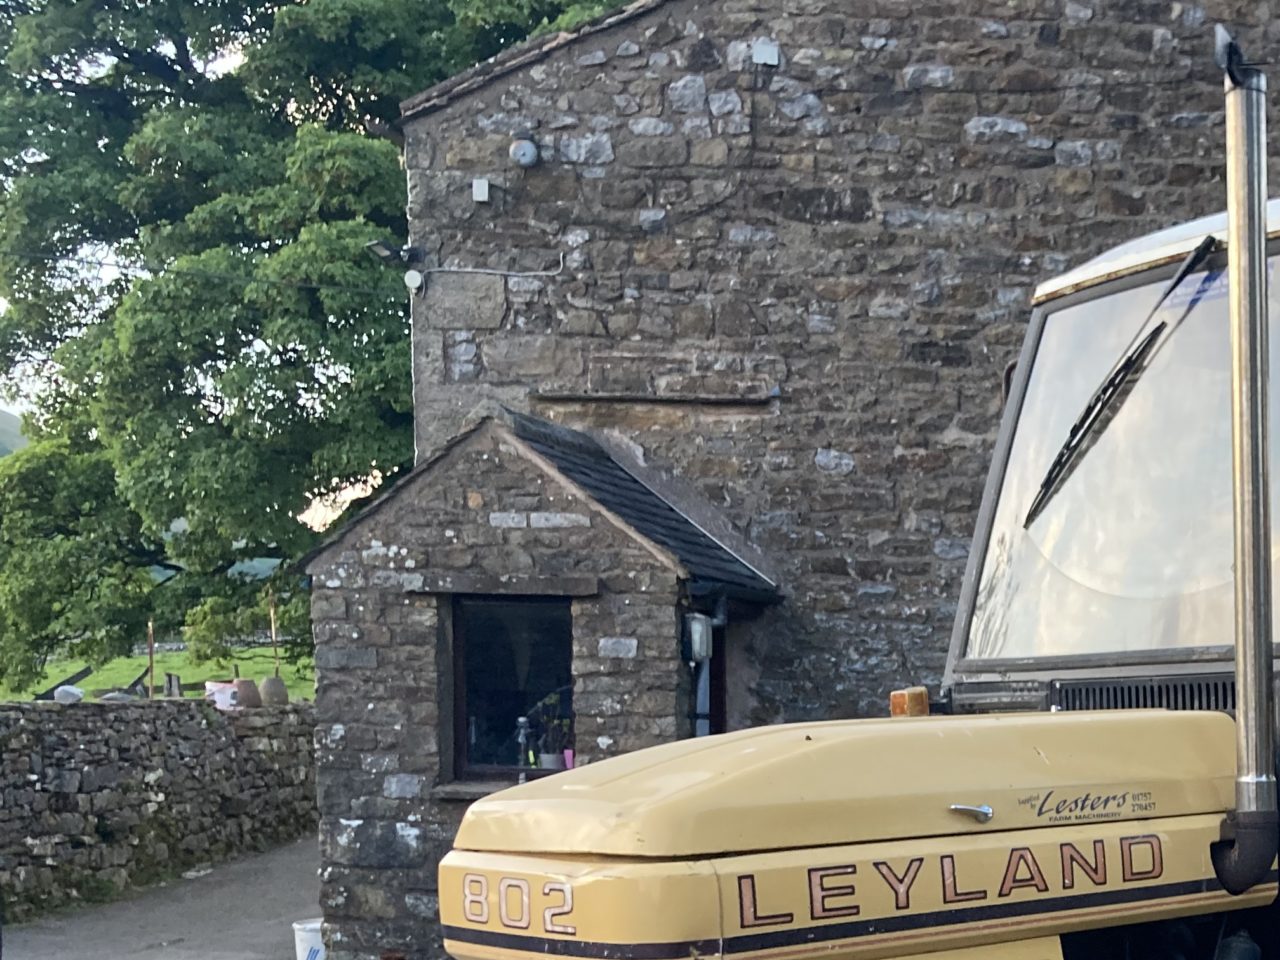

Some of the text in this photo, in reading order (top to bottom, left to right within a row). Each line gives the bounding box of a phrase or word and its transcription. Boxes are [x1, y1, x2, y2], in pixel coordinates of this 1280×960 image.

[1037, 790, 1131, 817] Lesters
[1048, 812, 1121, 823] FARM MACHINERY
[737, 833, 1164, 929] LEYLAND
[463, 872, 577, 936] 802
